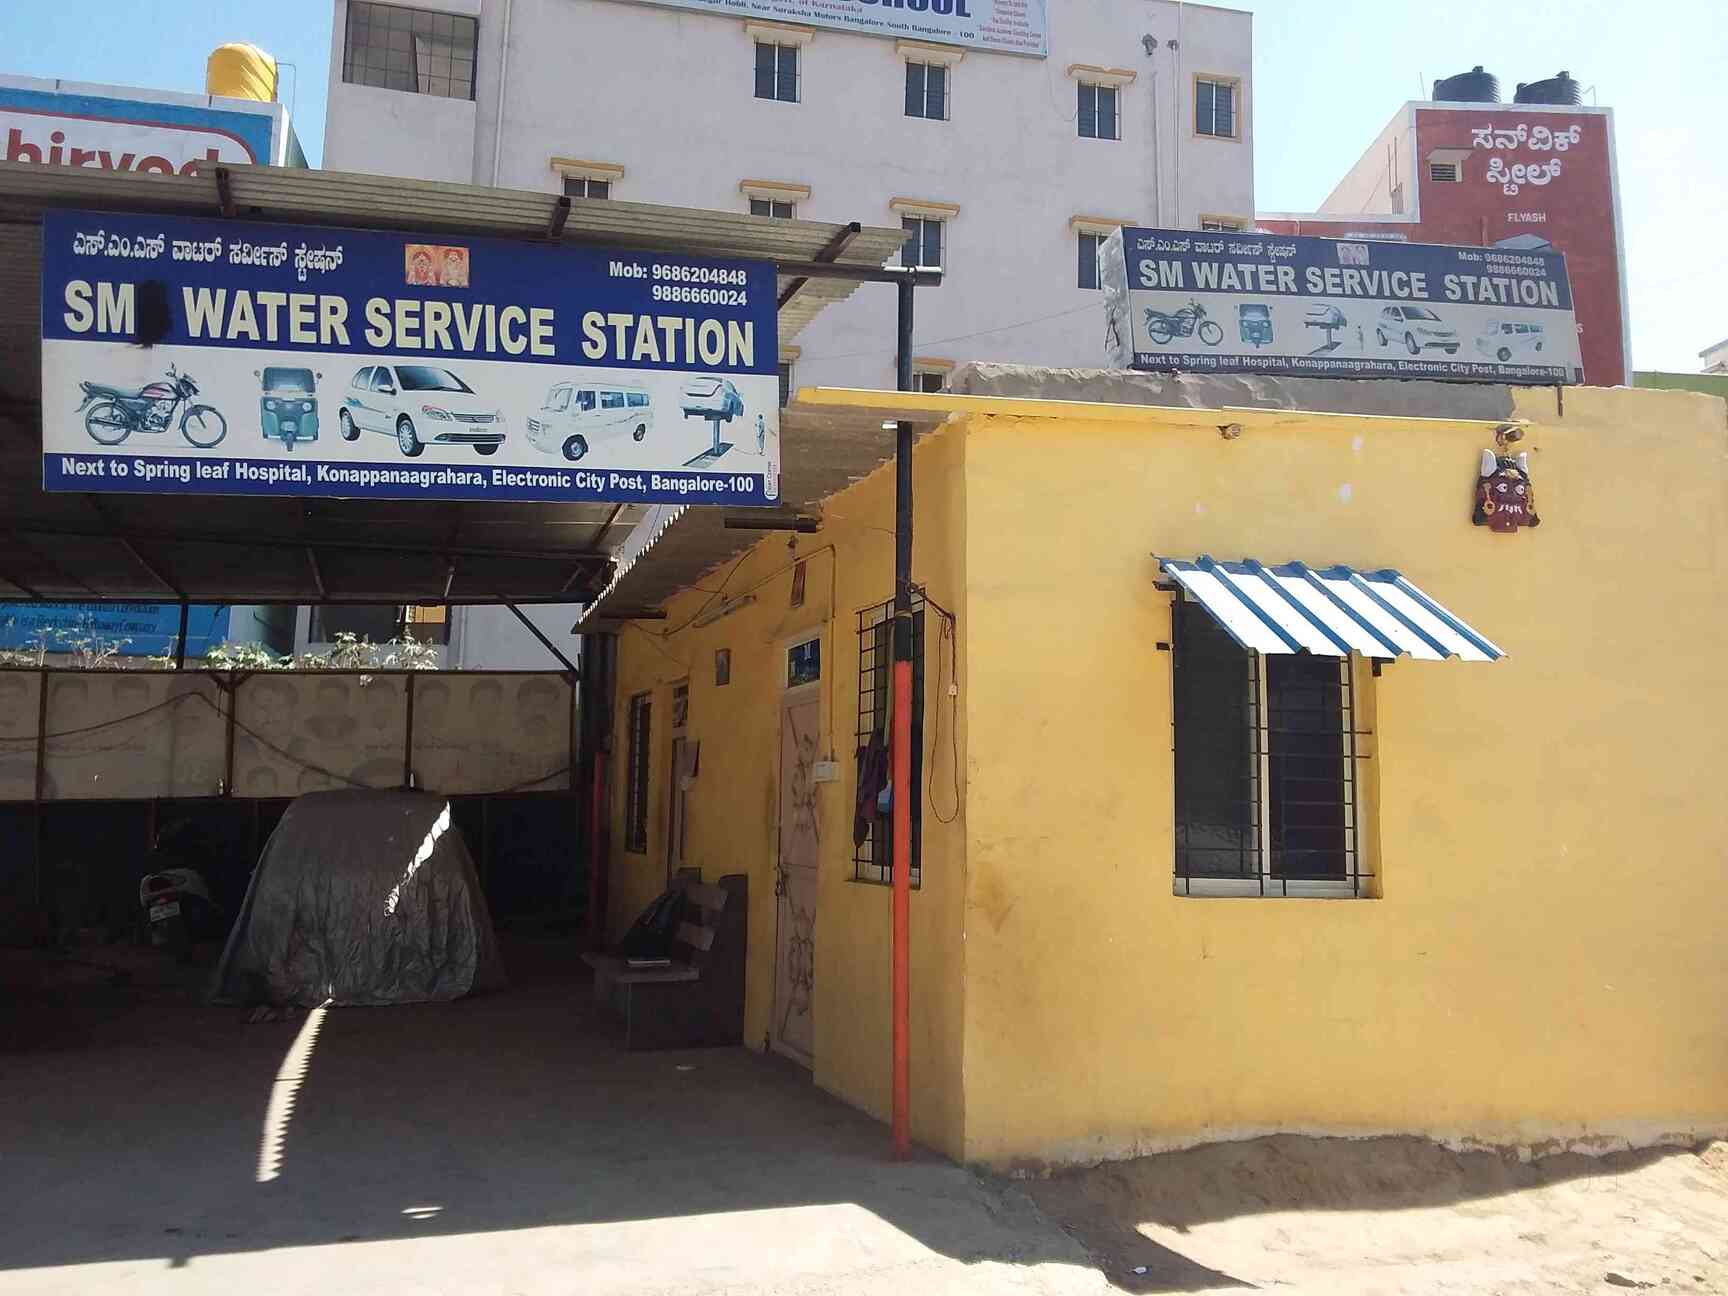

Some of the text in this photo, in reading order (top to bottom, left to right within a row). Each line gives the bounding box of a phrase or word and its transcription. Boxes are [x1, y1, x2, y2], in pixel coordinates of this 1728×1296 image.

[844, 15, 885, 28] Bangalore
[887, 21, 910, 31] South
[959, 31, 975, 39] 100
[1507, 213, 1546, 223] FLYASH
[1458, 251, 1483, 262] Mob:
[609, 260, 747, 286] Mob: 9686204848
[1139, 259, 1559, 307] SM WATER SERVICE STATION
[652, 285, 748, 307] 9886660024
[183, 286, 352, 346] WATER
[364, 297, 556, 357] SERVICE
[581, 311, 755, 368] STATION
[1140, 354, 1166, 365] Next
[1169, 355, 1180, 365] to
[1182, 355, 1217, 368] Spring
[1219, 356, 1239, 366] leaf
[1242, 357, 1289, 369] Hospital,
[1291, 358, 1396, 372] Konappanaagrahara,
[1398, 362, 1448, 373] Electronic
[1450, 363, 1469, 375] City
[1472, 365, 1496, 376] Post,
[62, 456, 104, 477] Next
[110, 459, 129, 478] to
[134, 460, 190, 483] Spring
[197, 462, 229, 480] leaf
[235, 463, 312, 485] Hospital,
[317, 465, 487, 490] Konappanaagrahara,
[492, 468, 571, 490] Electronic
[576, 471, 606, 494] City
[610, 474, 647, 494] Post,
[651, 475, 754, 496] Bangalore-100
